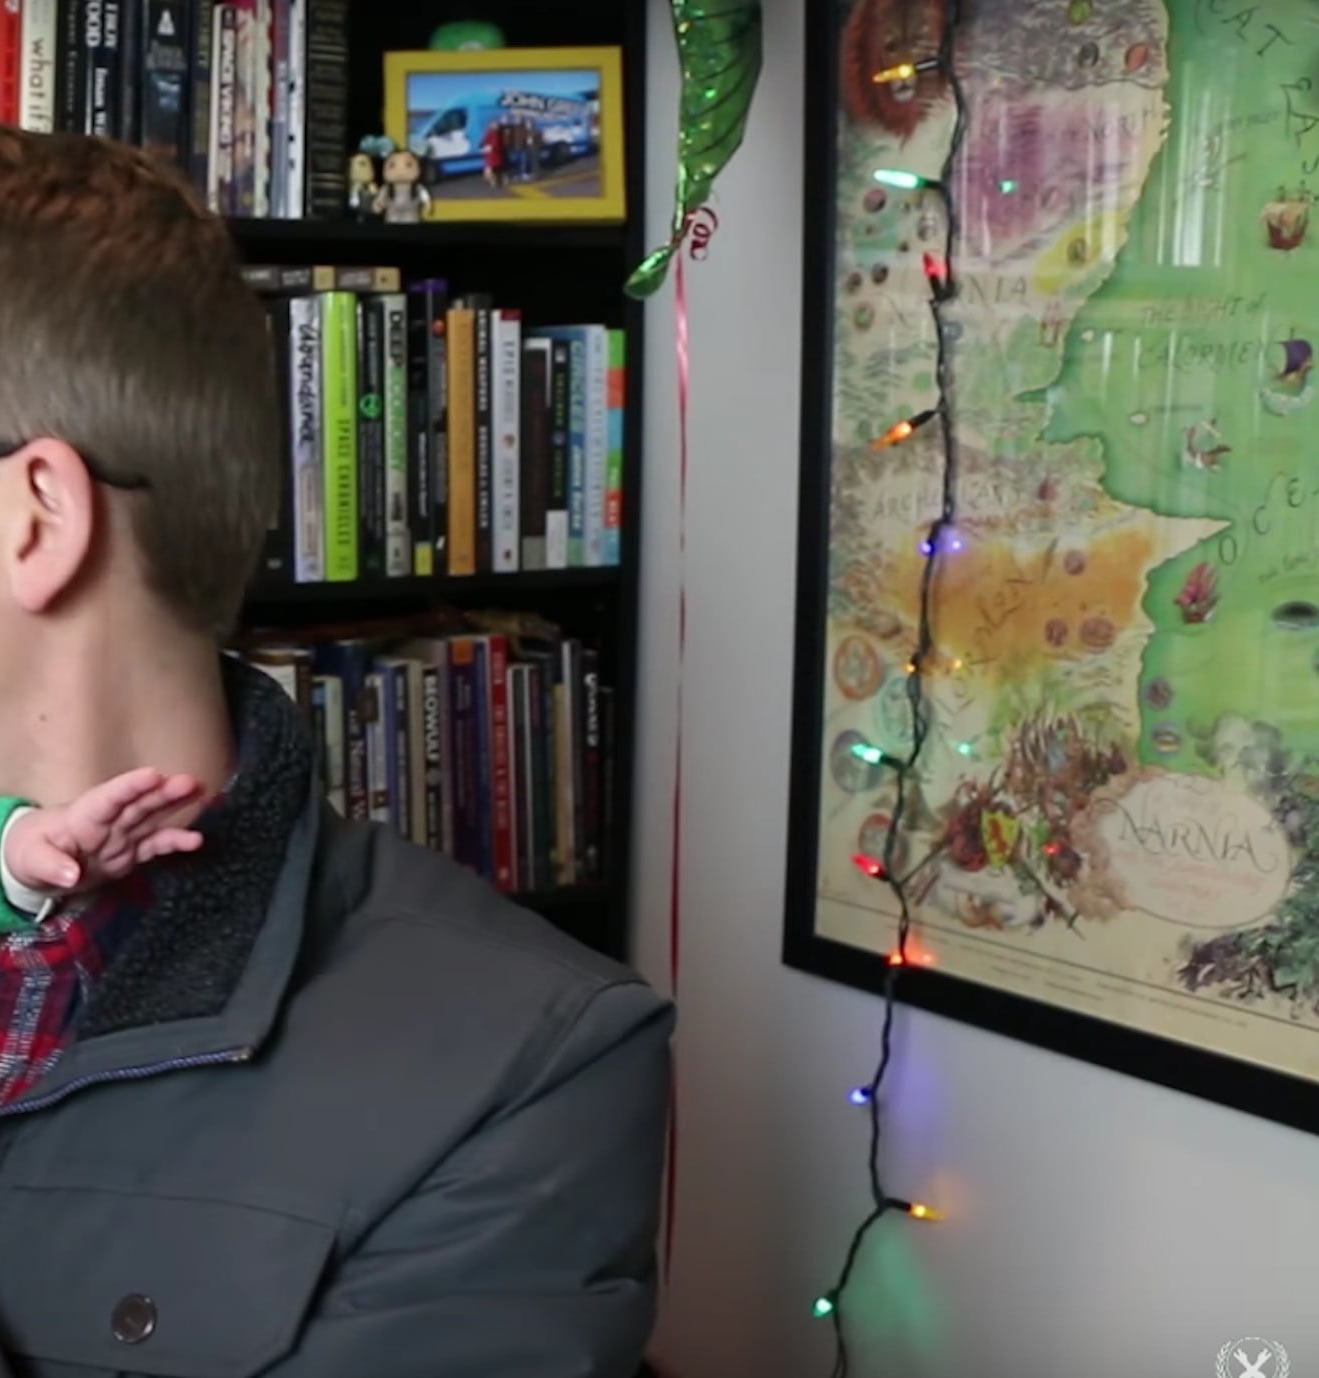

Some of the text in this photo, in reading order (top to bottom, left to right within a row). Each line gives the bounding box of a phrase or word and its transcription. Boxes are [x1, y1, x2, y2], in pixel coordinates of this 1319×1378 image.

[28, 38, 53, 99] what
[389, 310, 406, 367] DEEP
[335, 419, 352, 458] SPACE
[336, 465, 352, 546] CHRONICLES
[424, 674, 440, 762] BEOWULF
[1106, 799, 1280, 875] NARNIA
